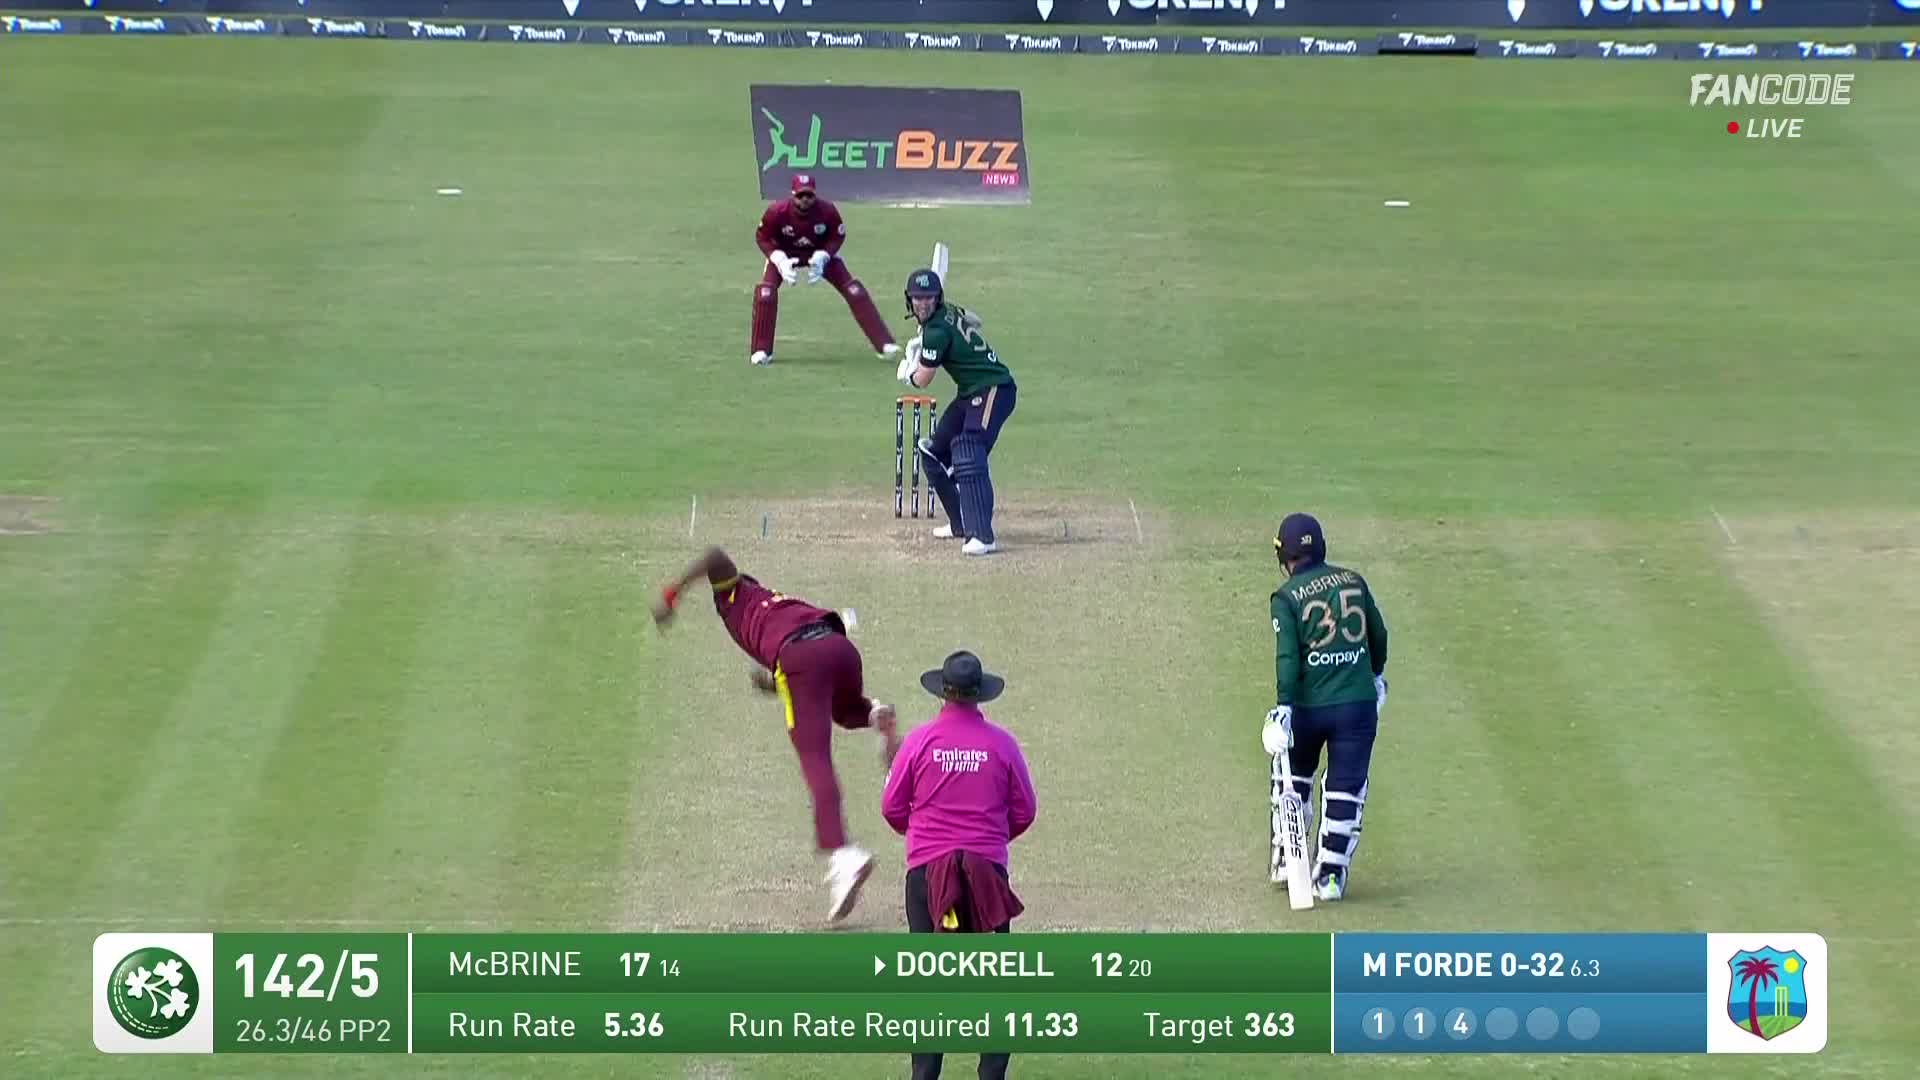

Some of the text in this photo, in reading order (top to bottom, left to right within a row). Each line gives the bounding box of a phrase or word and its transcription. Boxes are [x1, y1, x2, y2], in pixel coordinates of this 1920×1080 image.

[985, 174, 1016, 185] NEWS
[1291, 573, 1359, 601] McBRINE
[1302, 588, 1367, 649] 35
[933, 748, 989, 762] Emirates
